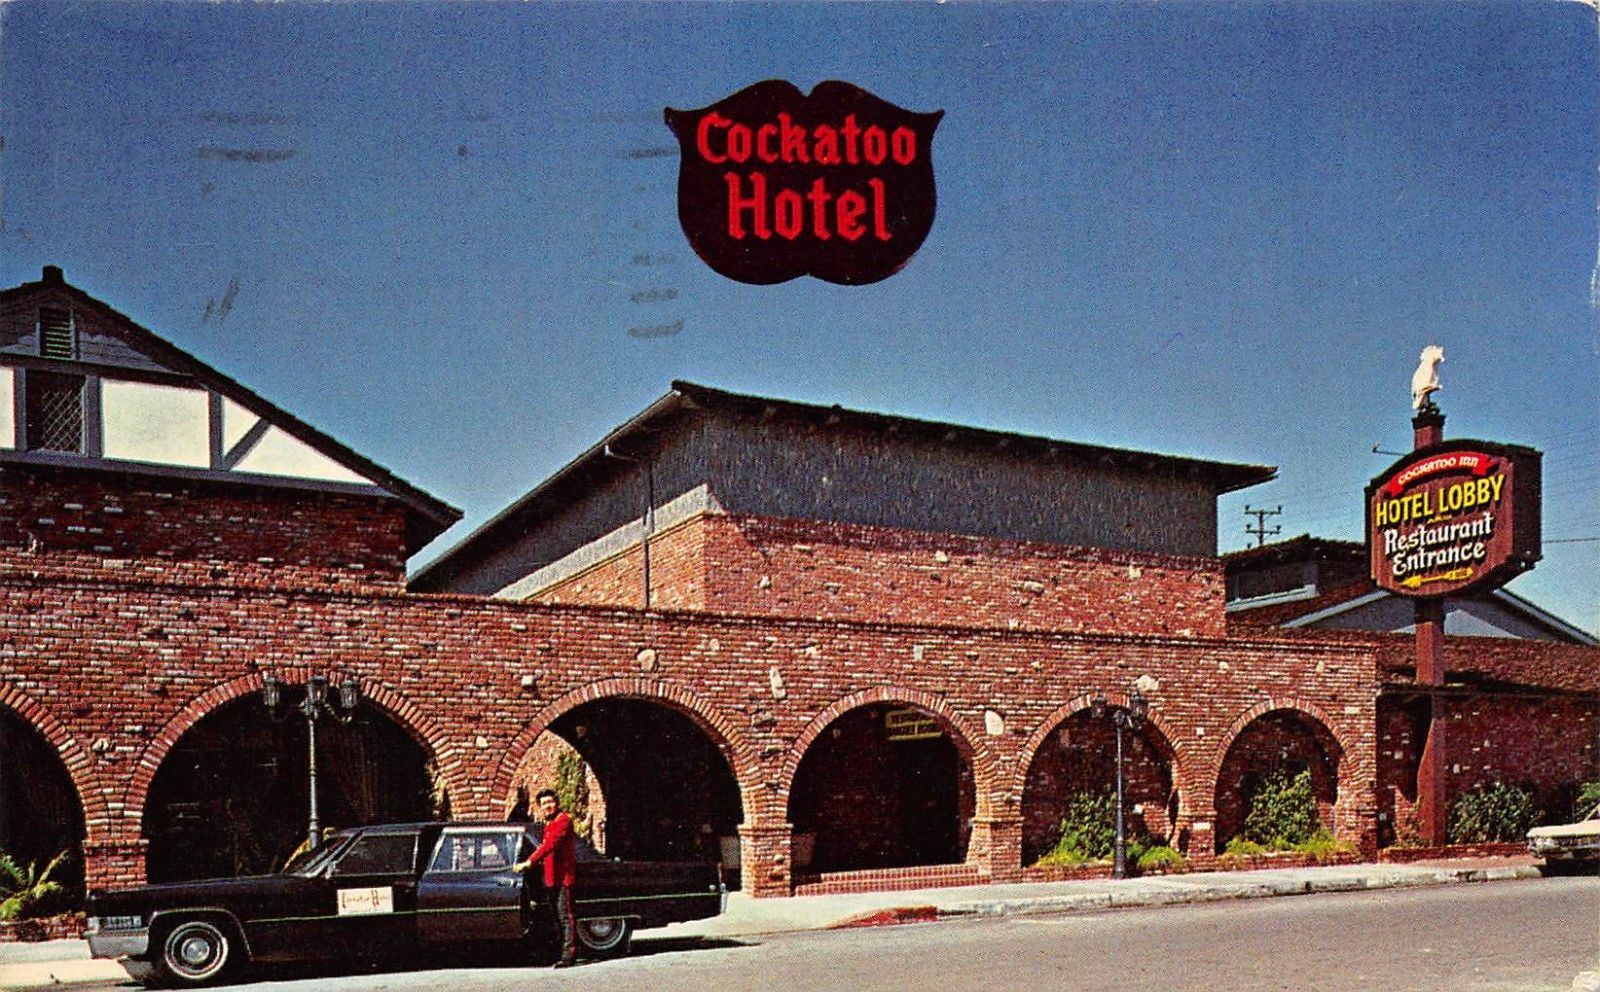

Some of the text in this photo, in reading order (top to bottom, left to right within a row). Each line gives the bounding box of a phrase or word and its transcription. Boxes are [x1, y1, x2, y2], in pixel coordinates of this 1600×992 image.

[1376, 474, 1505, 526] HOTEL LOBBY
[1384, 511, 1494, 555] Restaurant
[1392, 542, 1485, 576] Entrance
